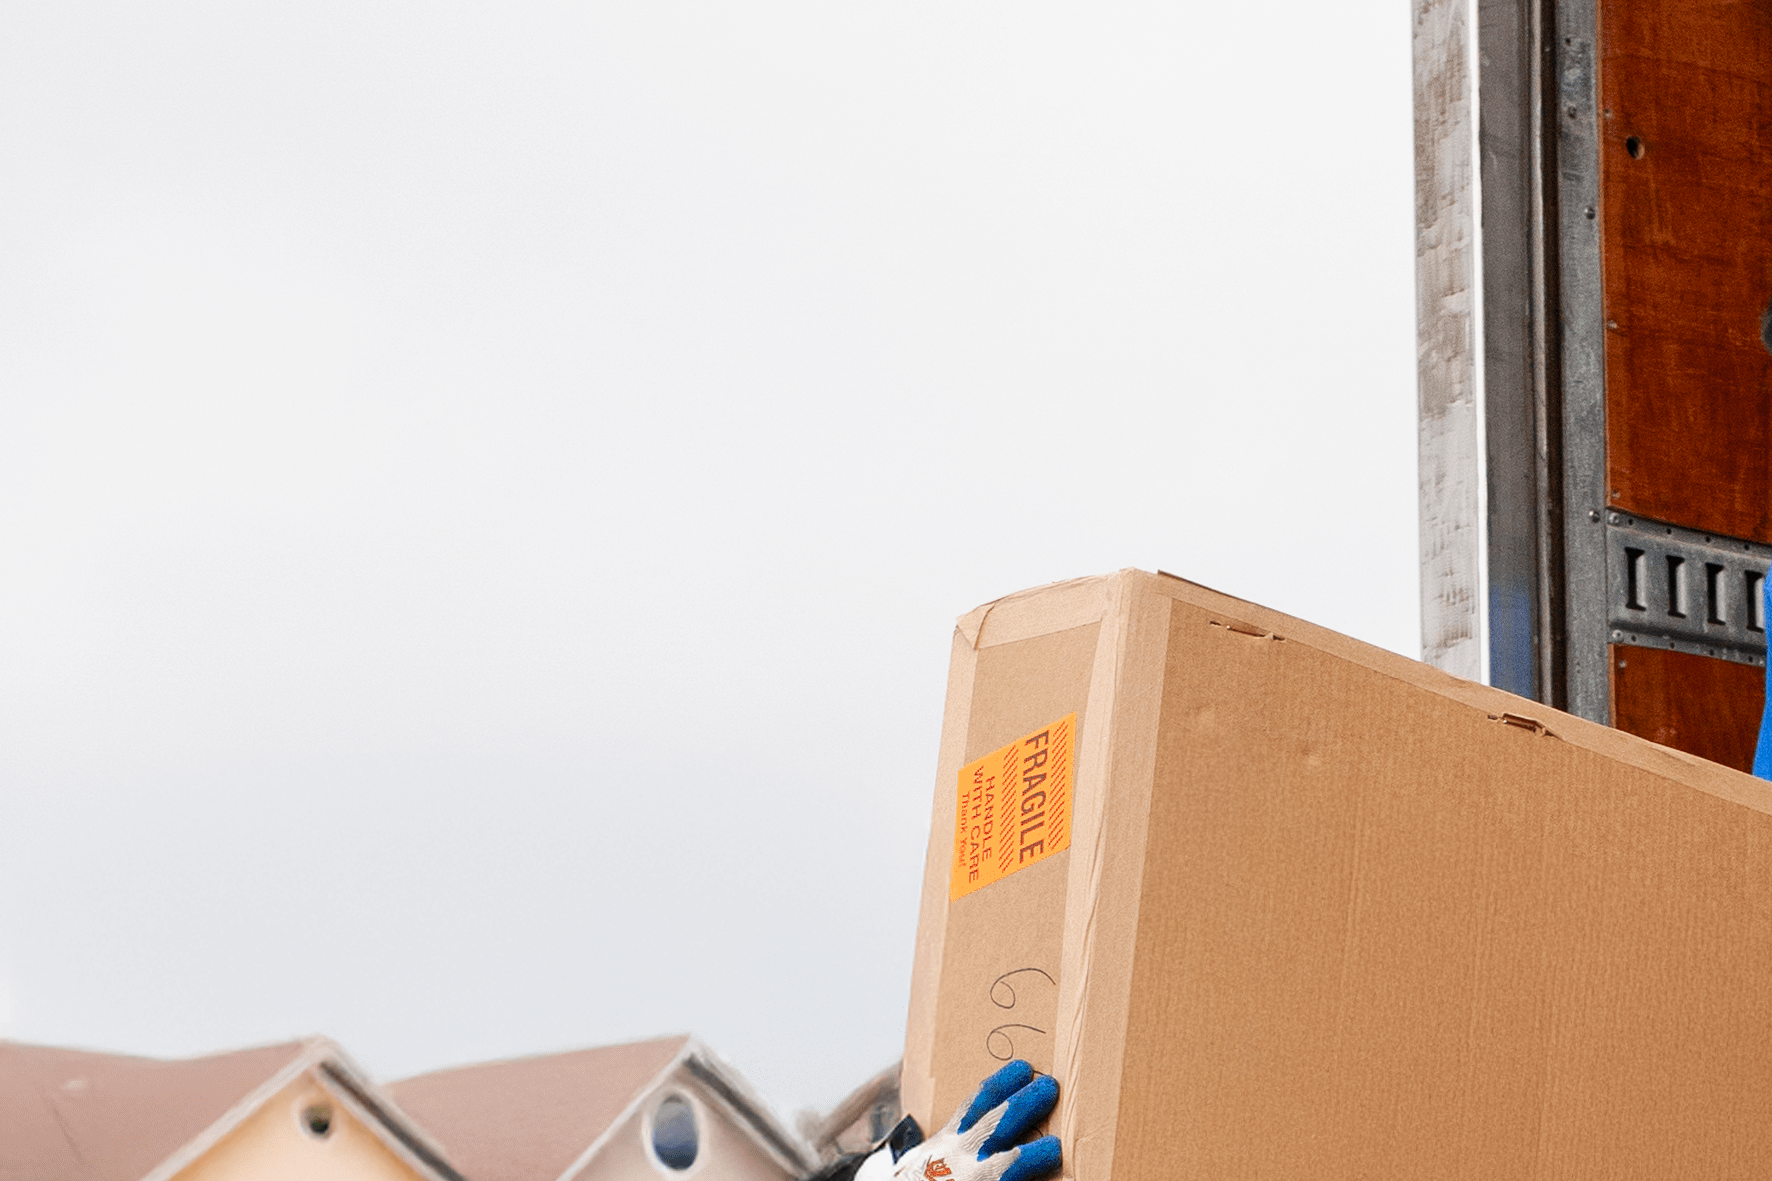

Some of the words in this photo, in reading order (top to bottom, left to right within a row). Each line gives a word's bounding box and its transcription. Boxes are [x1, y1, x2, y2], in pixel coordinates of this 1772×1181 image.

[961, 791, 970, 834] Thank
[971, 764, 985, 820] WITH
[982, 775, 996, 863] HANDLE
[1018, 730, 1050, 864] FRAGILE
[968, 825, 982, 885] CARE
